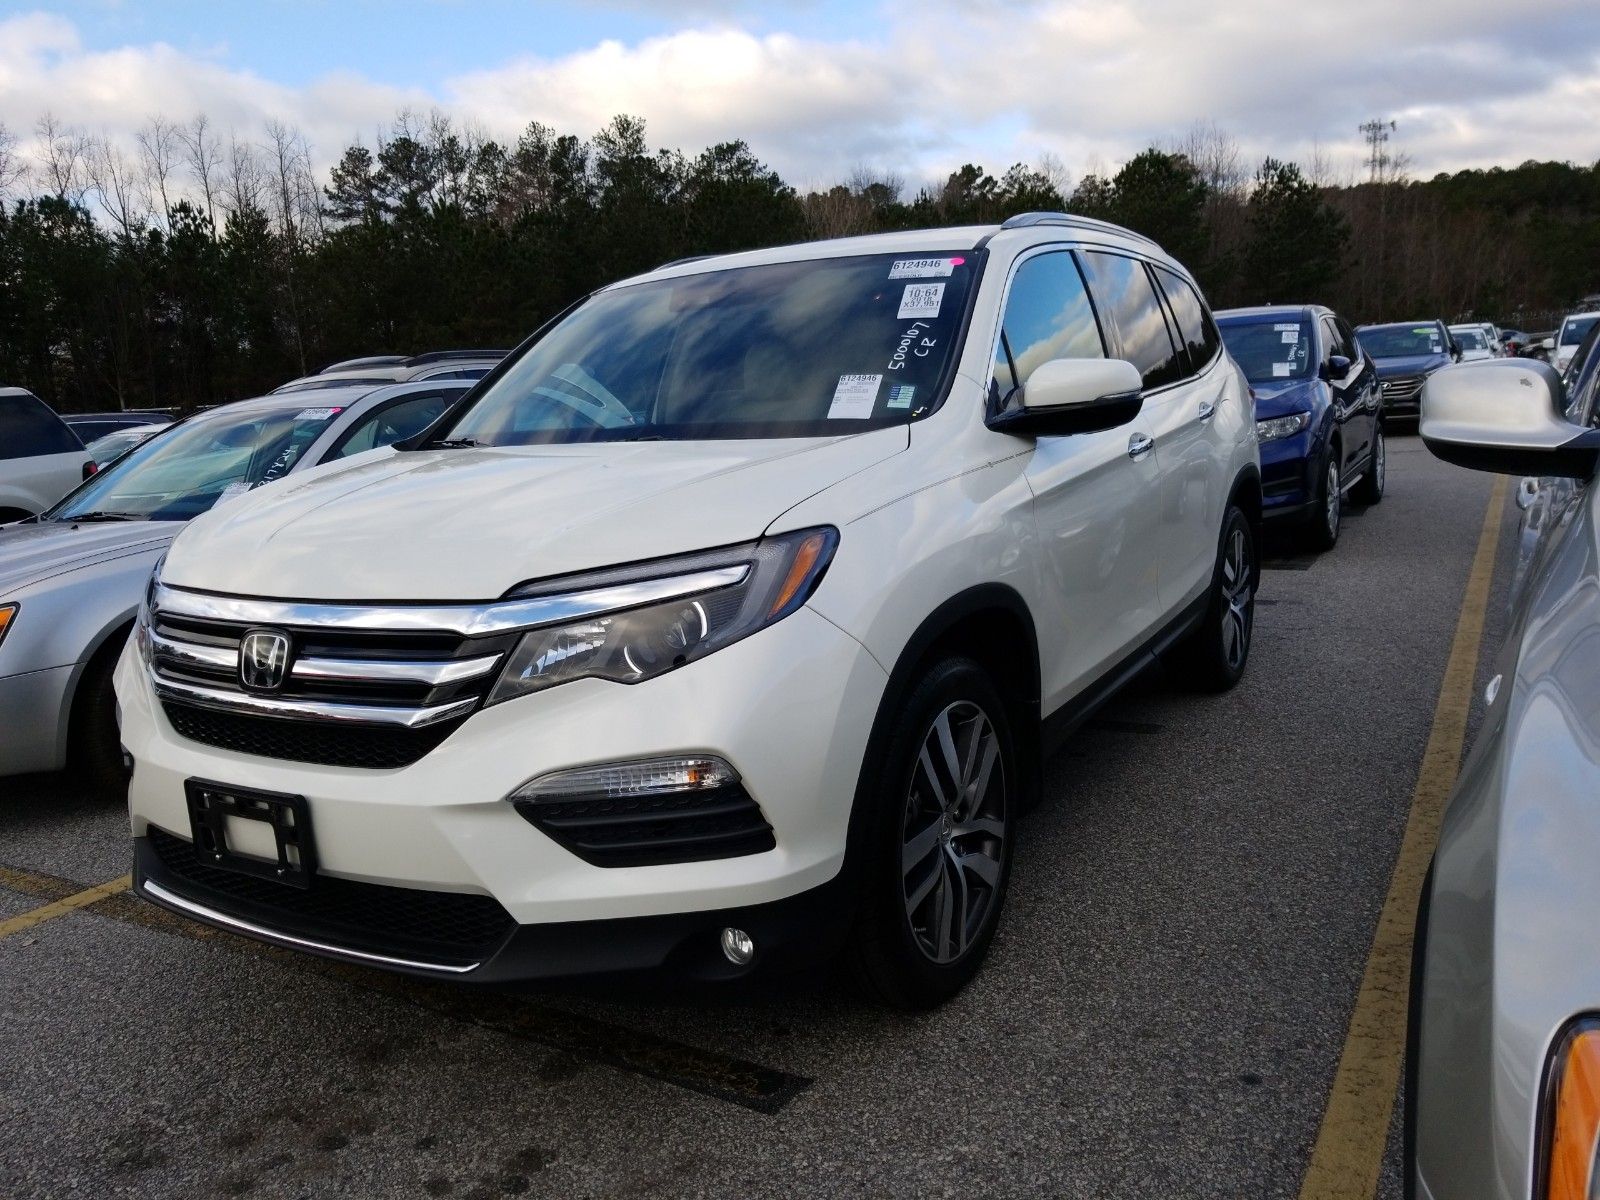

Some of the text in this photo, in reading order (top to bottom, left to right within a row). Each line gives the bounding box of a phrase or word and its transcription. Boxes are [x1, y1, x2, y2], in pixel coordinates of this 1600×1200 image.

[893, 260, 941, 270] 6124946
[909, 288, 938, 298] 10:64
[914, 337, 937, 357] CR
